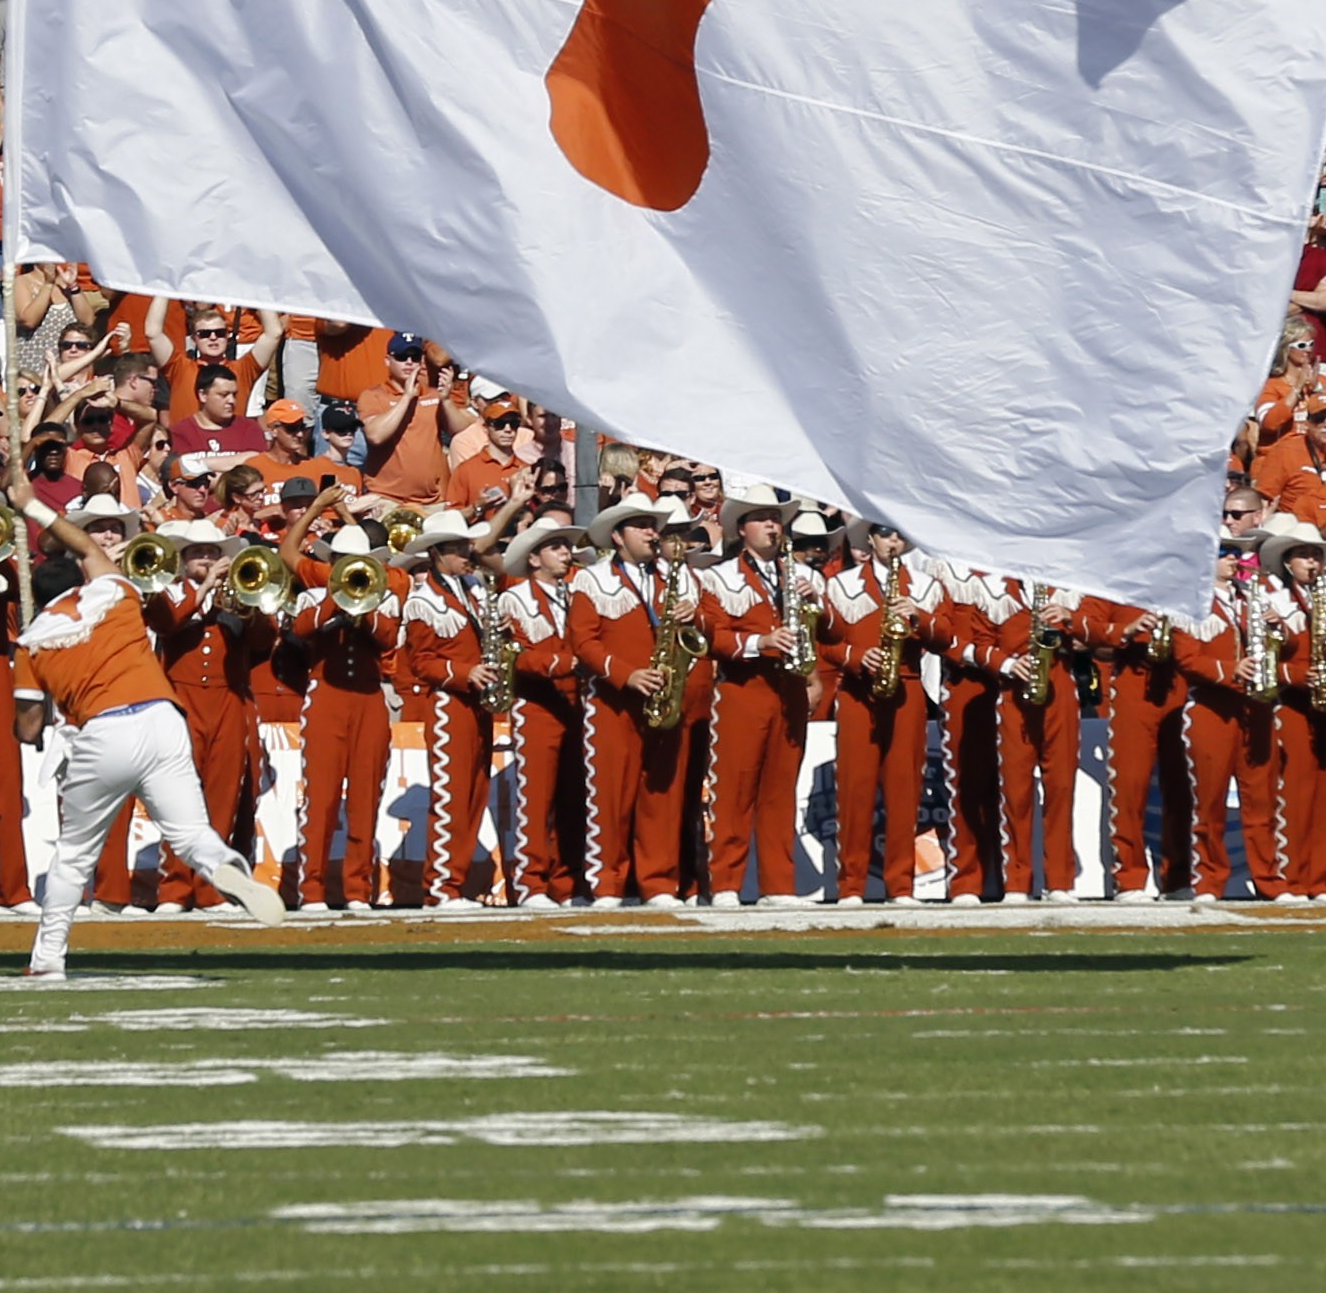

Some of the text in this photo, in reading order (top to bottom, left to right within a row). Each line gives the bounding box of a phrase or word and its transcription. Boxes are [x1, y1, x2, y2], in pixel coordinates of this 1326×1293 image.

[402, 333, 414, 342] T
[208, 438, 220, 452] OU
[297, 480, 308, 490] T
